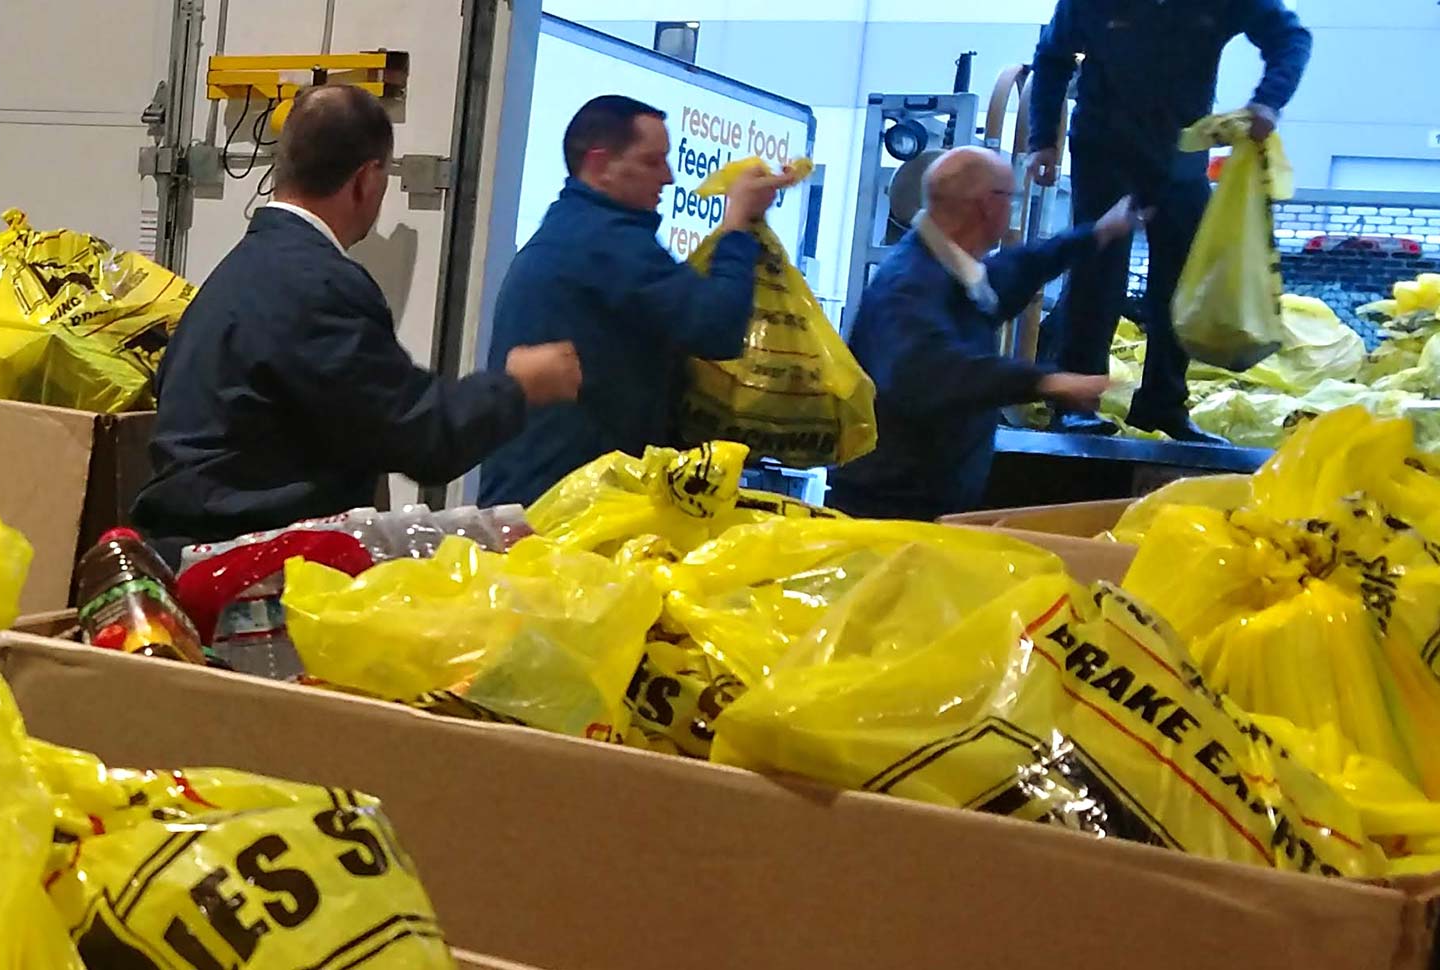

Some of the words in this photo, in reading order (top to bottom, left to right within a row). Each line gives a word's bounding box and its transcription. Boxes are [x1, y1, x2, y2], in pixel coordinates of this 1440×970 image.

[682, 105, 742, 149] rescue
[678, 137, 721, 179] feed
[672, 186, 727, 228] peop
[669, 226, 702, 255] rep
[313, 806, 388, 877] S
